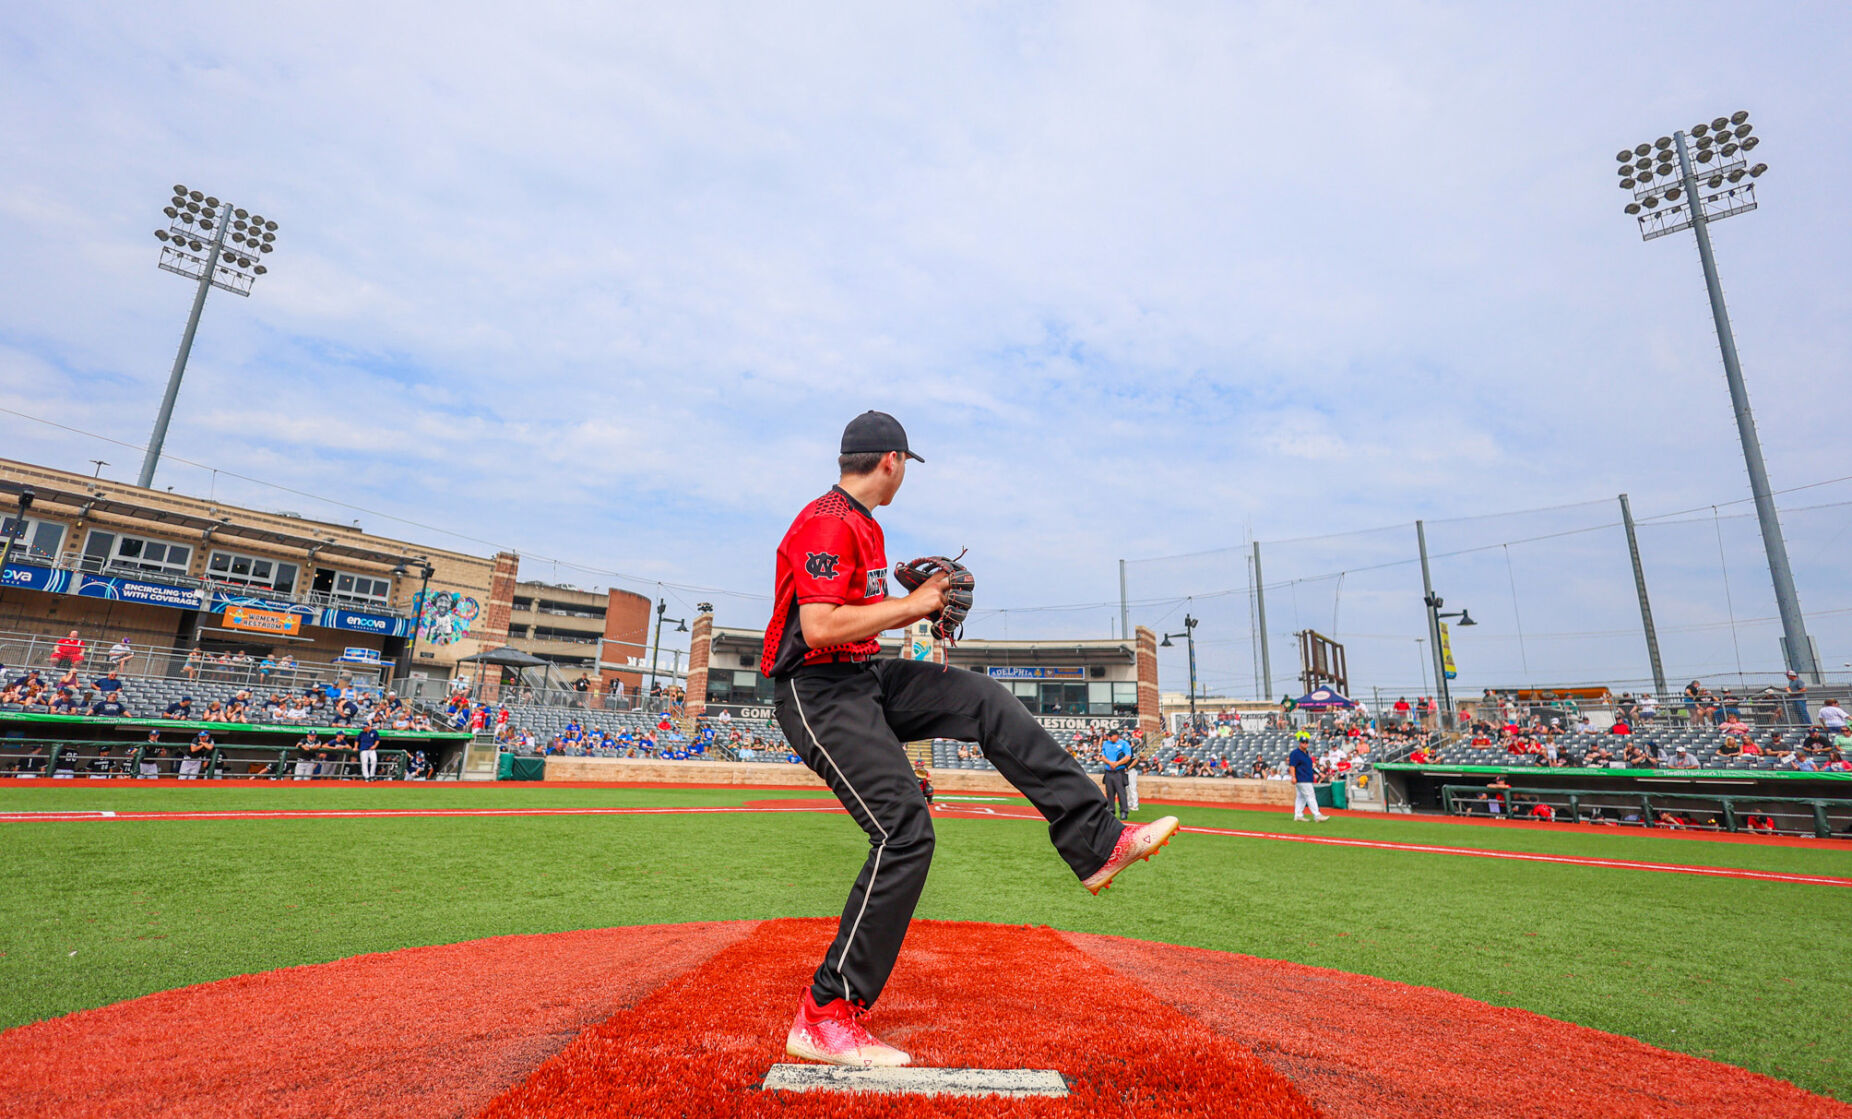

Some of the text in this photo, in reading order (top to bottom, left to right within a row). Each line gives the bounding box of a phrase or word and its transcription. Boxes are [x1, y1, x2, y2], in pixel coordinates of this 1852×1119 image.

[124, 583, 180, 597] ENCIRCLING
[122, 590, 200, 606] WITH COVERAGE.
[243, 619, 282, 630] RESTROOM
[346, 615, 386, 629] encova
